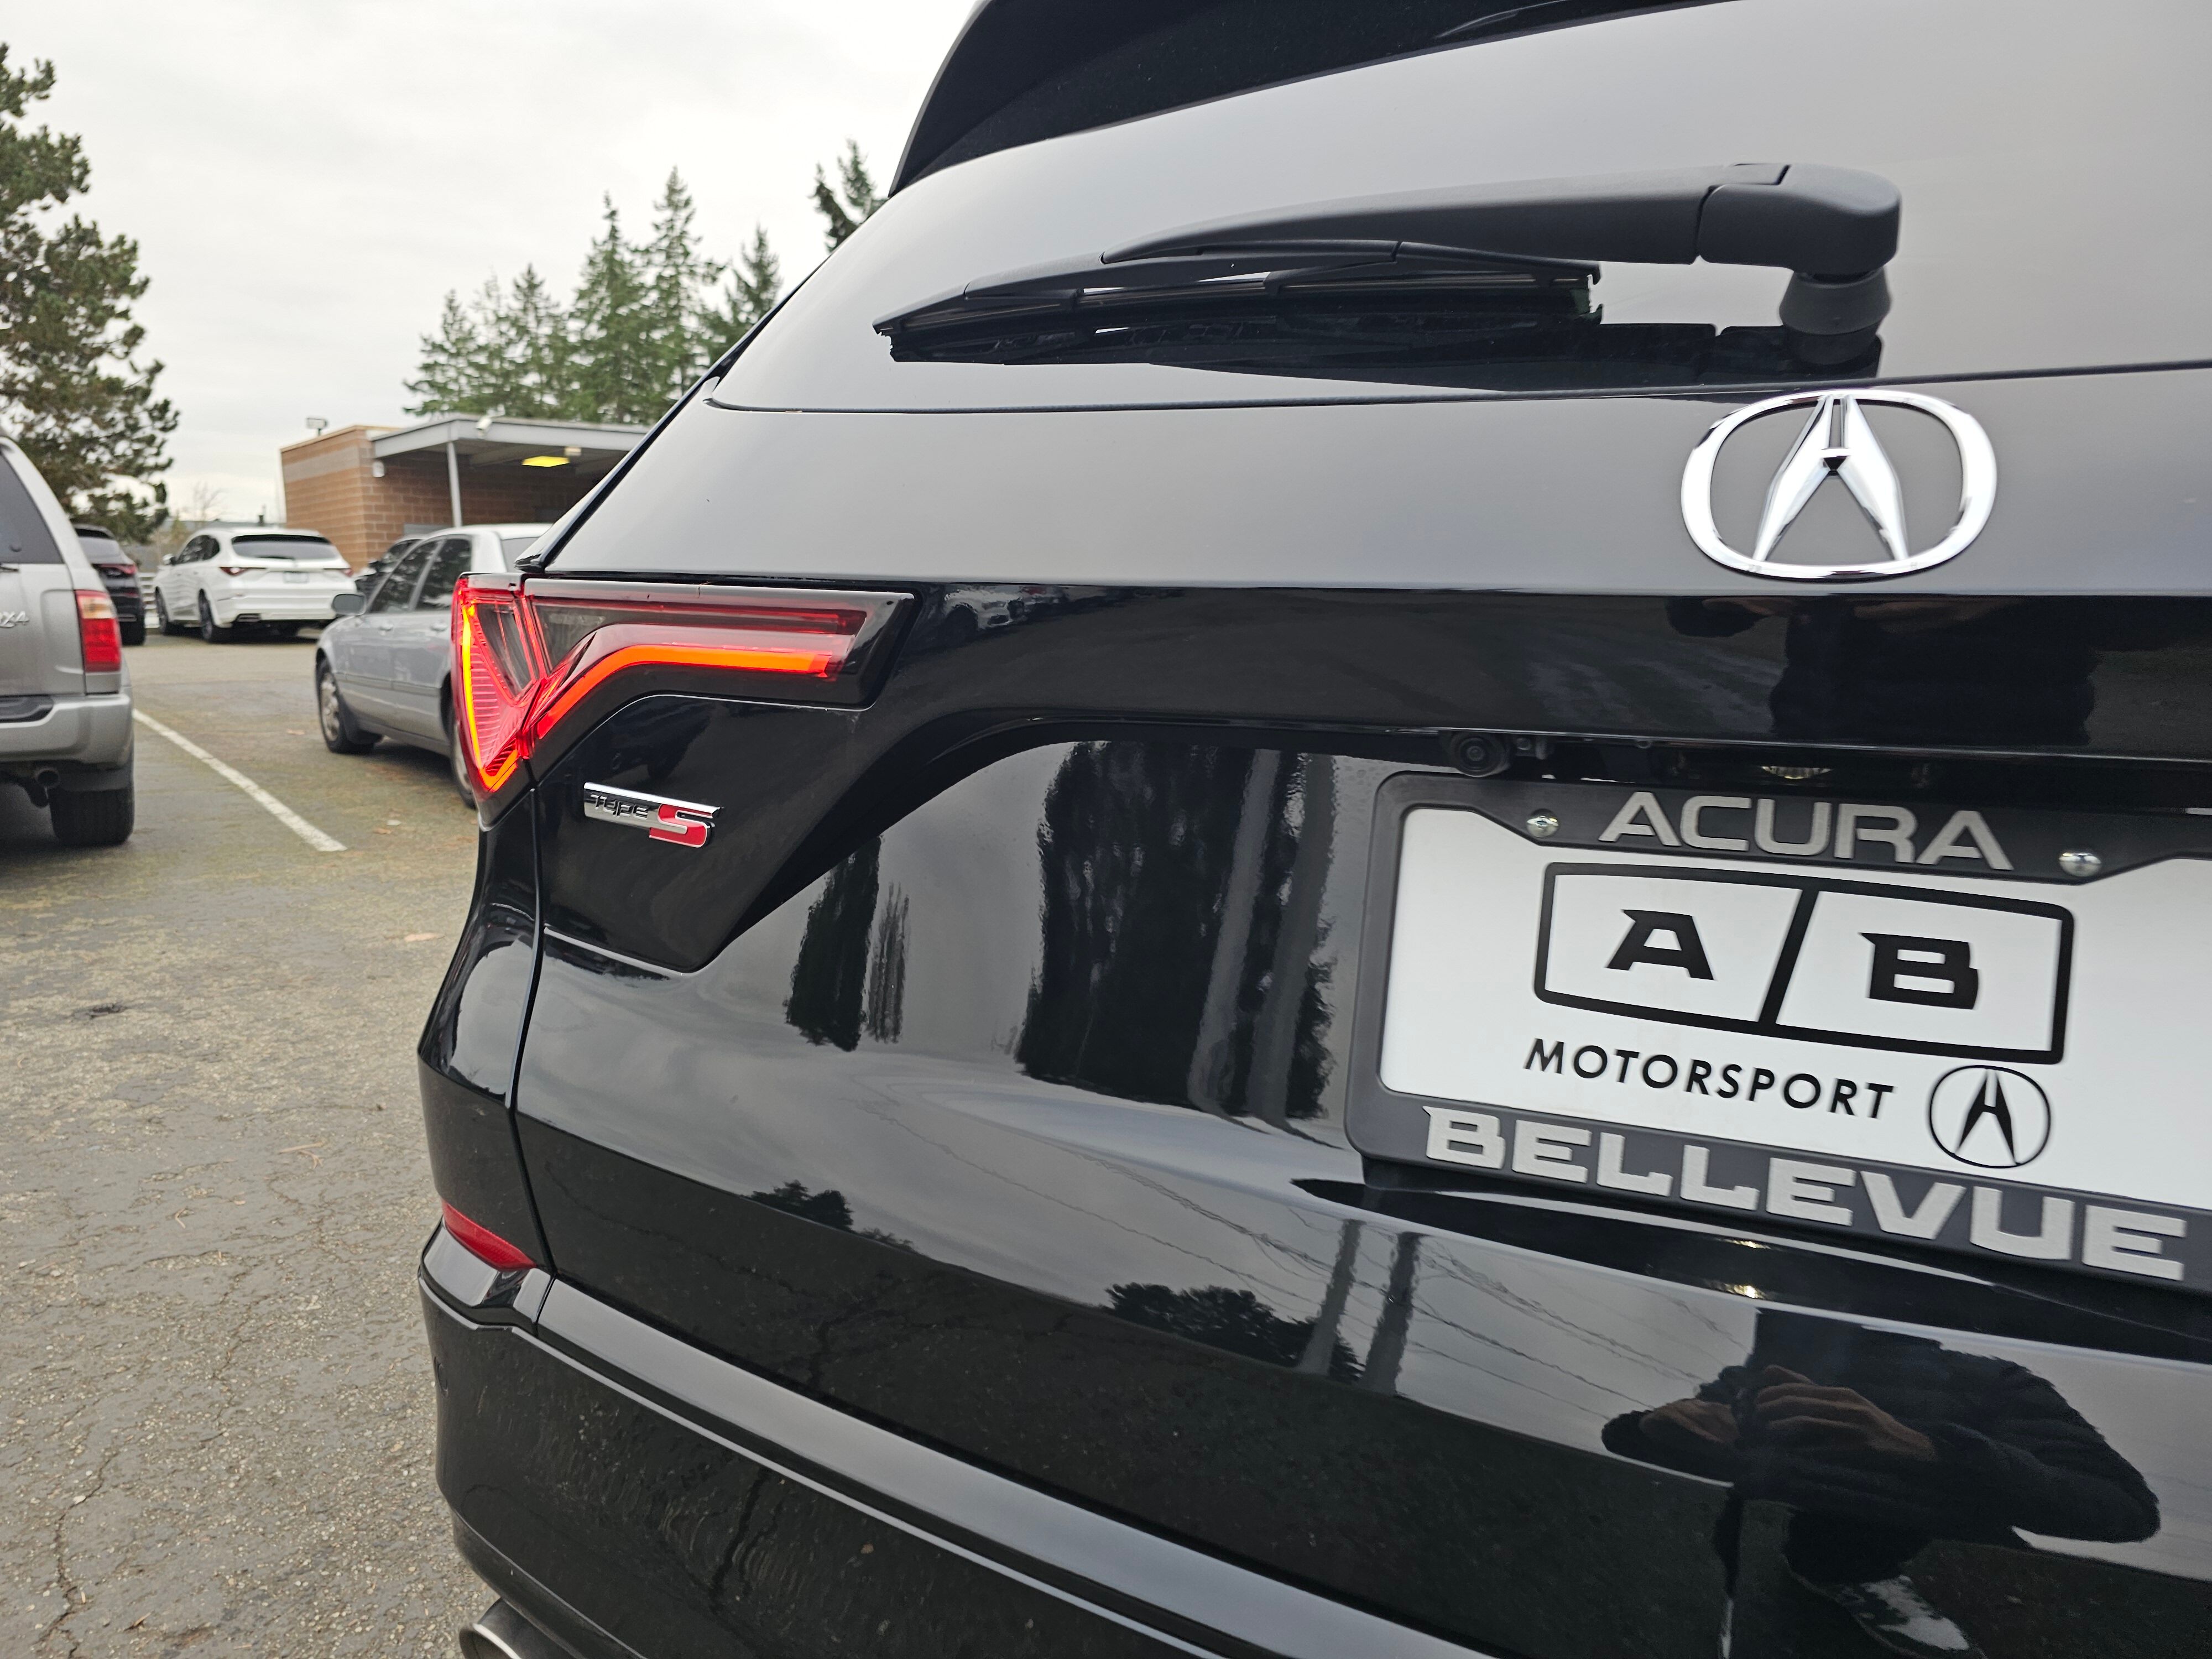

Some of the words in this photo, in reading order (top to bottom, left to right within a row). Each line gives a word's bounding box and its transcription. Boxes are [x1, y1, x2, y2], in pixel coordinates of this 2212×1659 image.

[649, 804, 714, 848] S
[1599, 791, 2013, 871] ACURA
[1605, 909, 1715, 981] A
[1859, 932, 1979, 1010] B
[1524, 1038, 1895, 1119] MOTORSPORT
[1423, 1105, 2186, 1281] BELLEVUE
